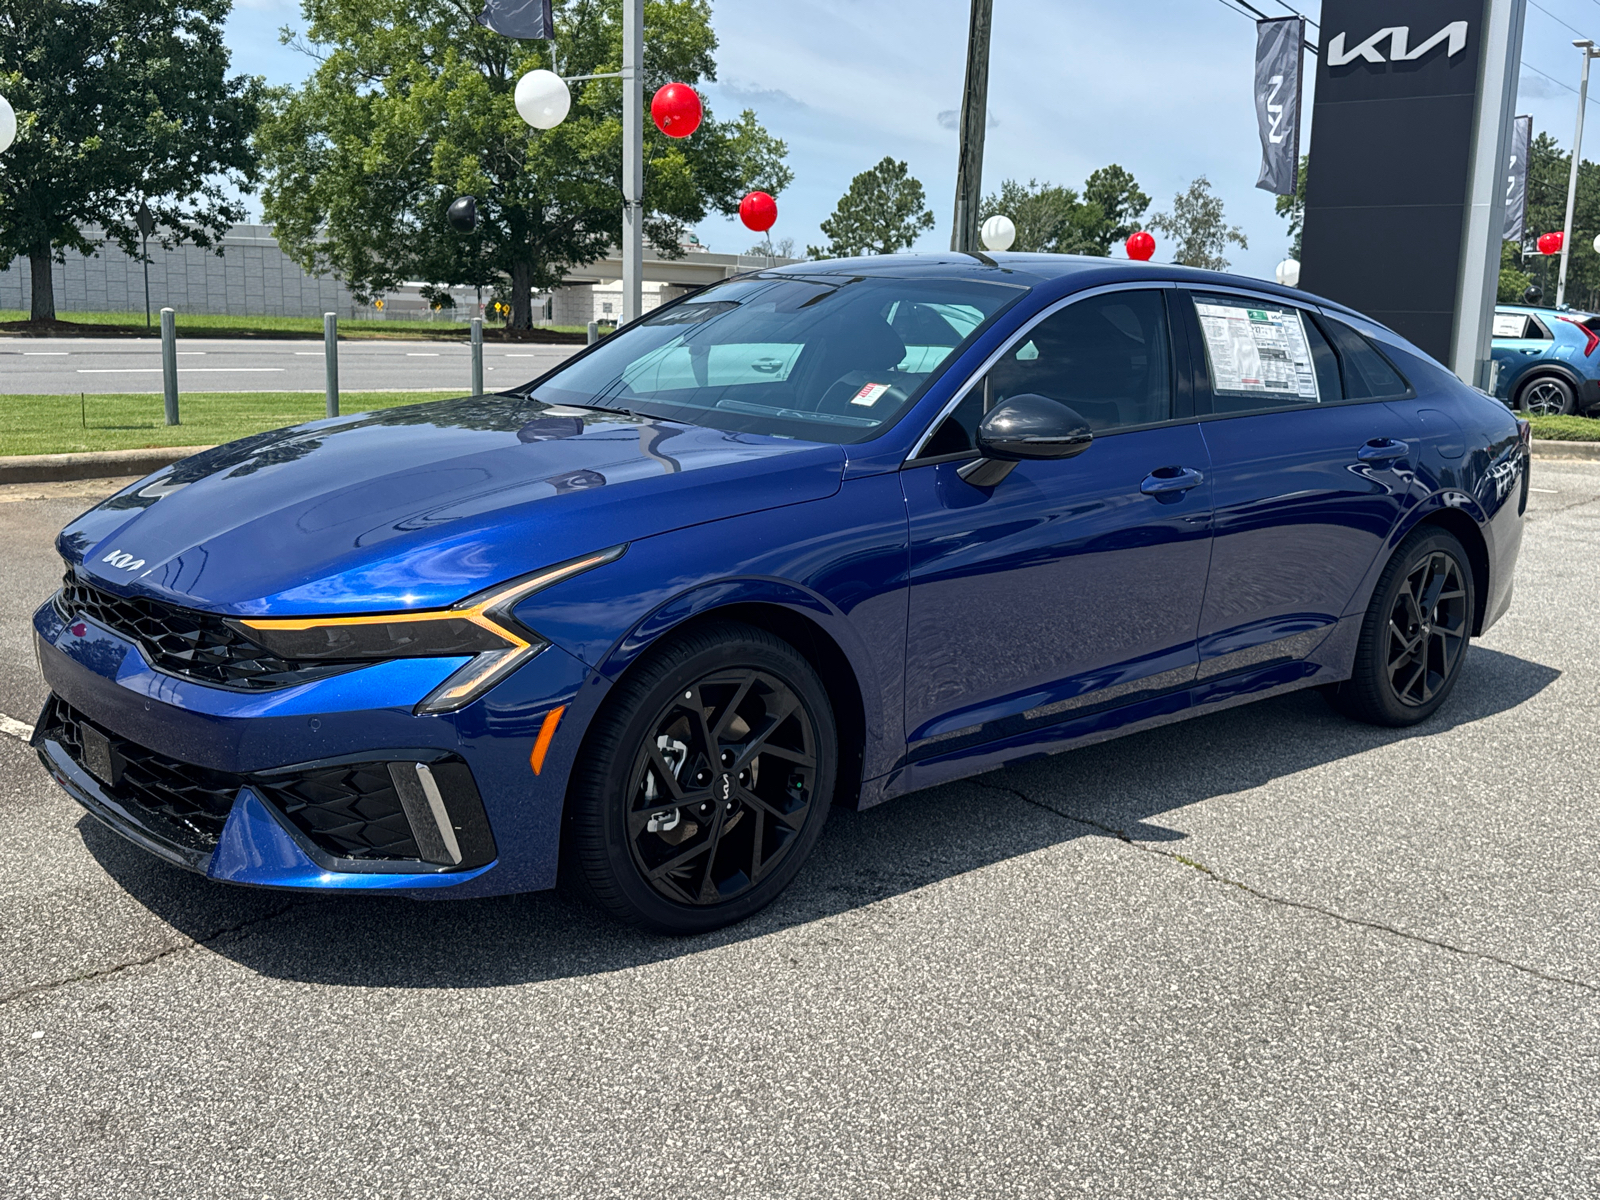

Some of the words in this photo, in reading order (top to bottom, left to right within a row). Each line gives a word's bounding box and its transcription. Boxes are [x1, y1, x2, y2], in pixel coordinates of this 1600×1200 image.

[1327, 20, 1468, 66] KIA
[1267, 75, 1284, 144] KIA
[102, 549, 146, 572] KIA
